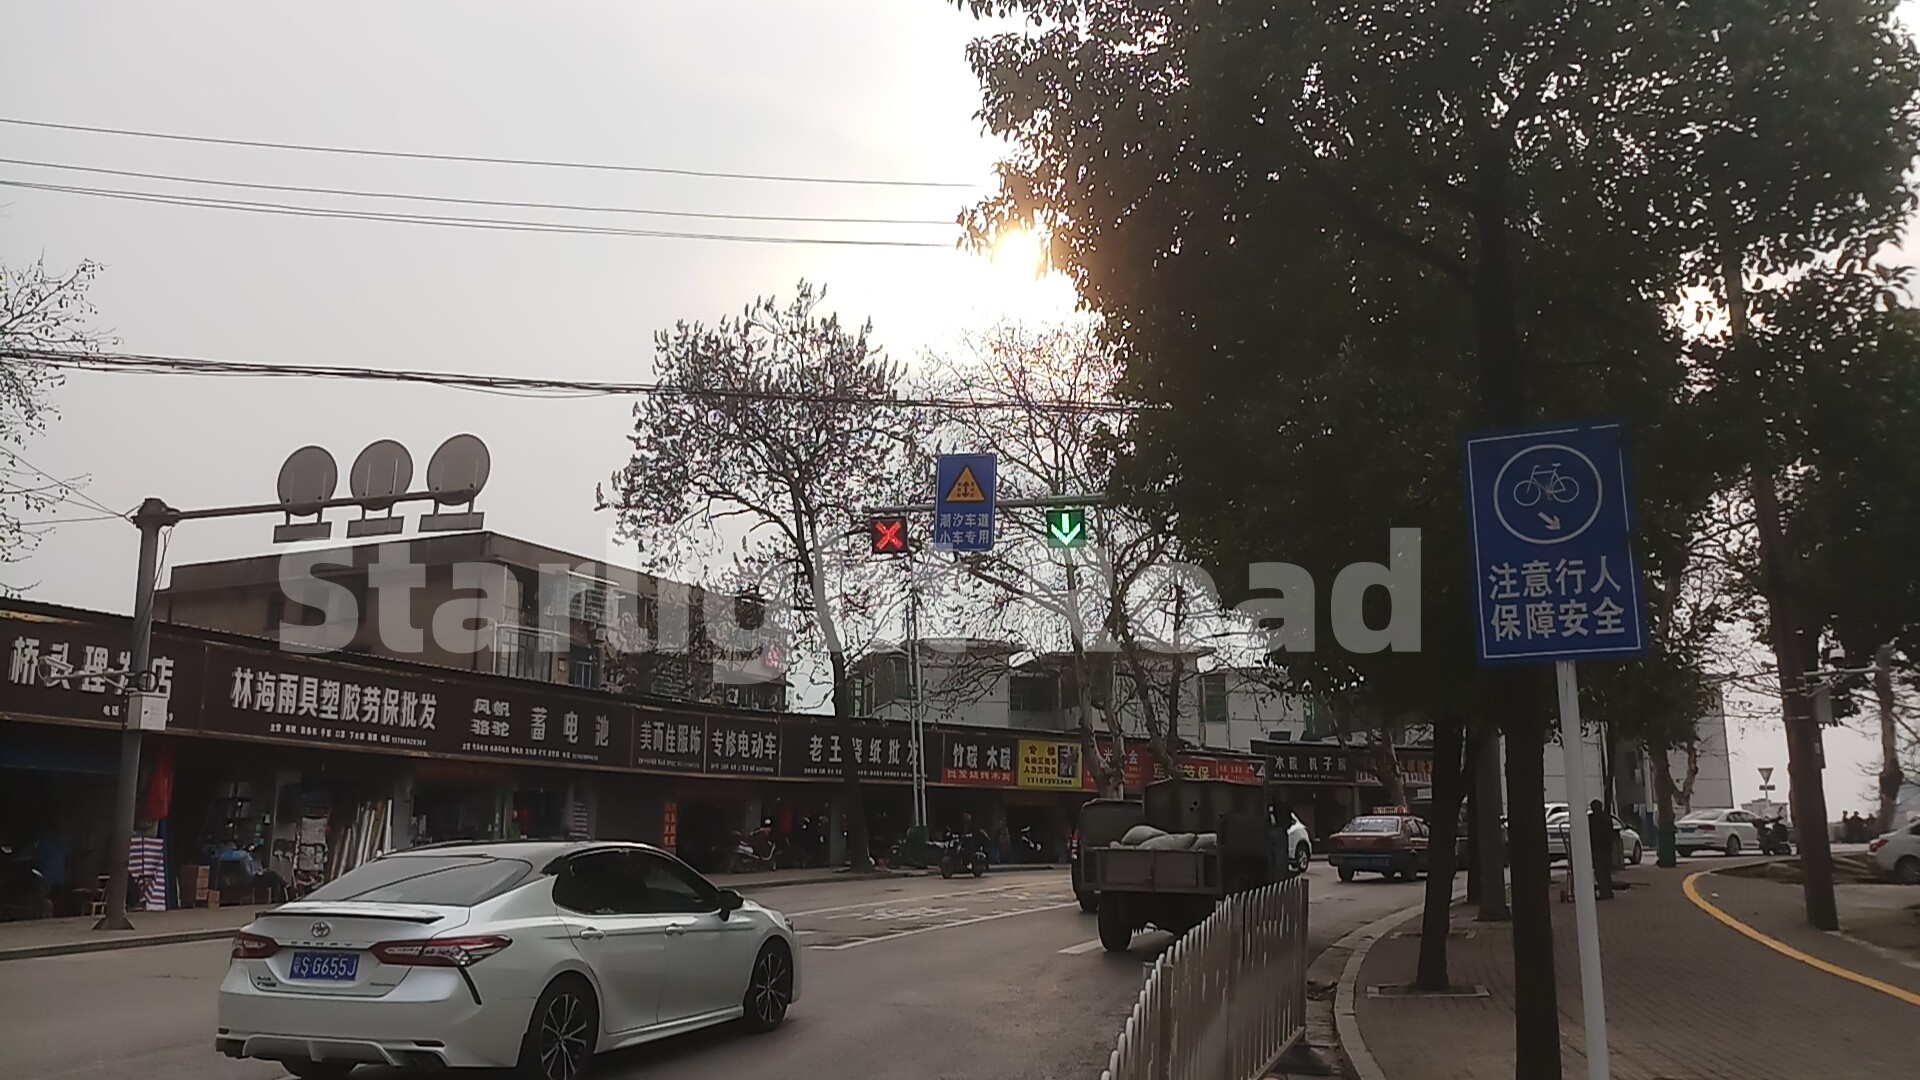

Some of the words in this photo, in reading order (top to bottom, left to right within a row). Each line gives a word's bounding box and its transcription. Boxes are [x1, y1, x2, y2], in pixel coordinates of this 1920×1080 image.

[940, 513, 989, 528] 潮汐车道
[940, 529, 989, 545] 小车专用
[1488, 555, 1621, 600] 注意行人
[1490, 596, 1625, 641] 保障安全
[230, 666, 437, 730] 林海雨具塑胶劳保批发
[470, 718, 510, 737] 骆驼
[473, 698, 510, 717] 风帆
[530, 706, 609, 747] 蓄电池
[711, 729, 777, 760] 专修电动车
